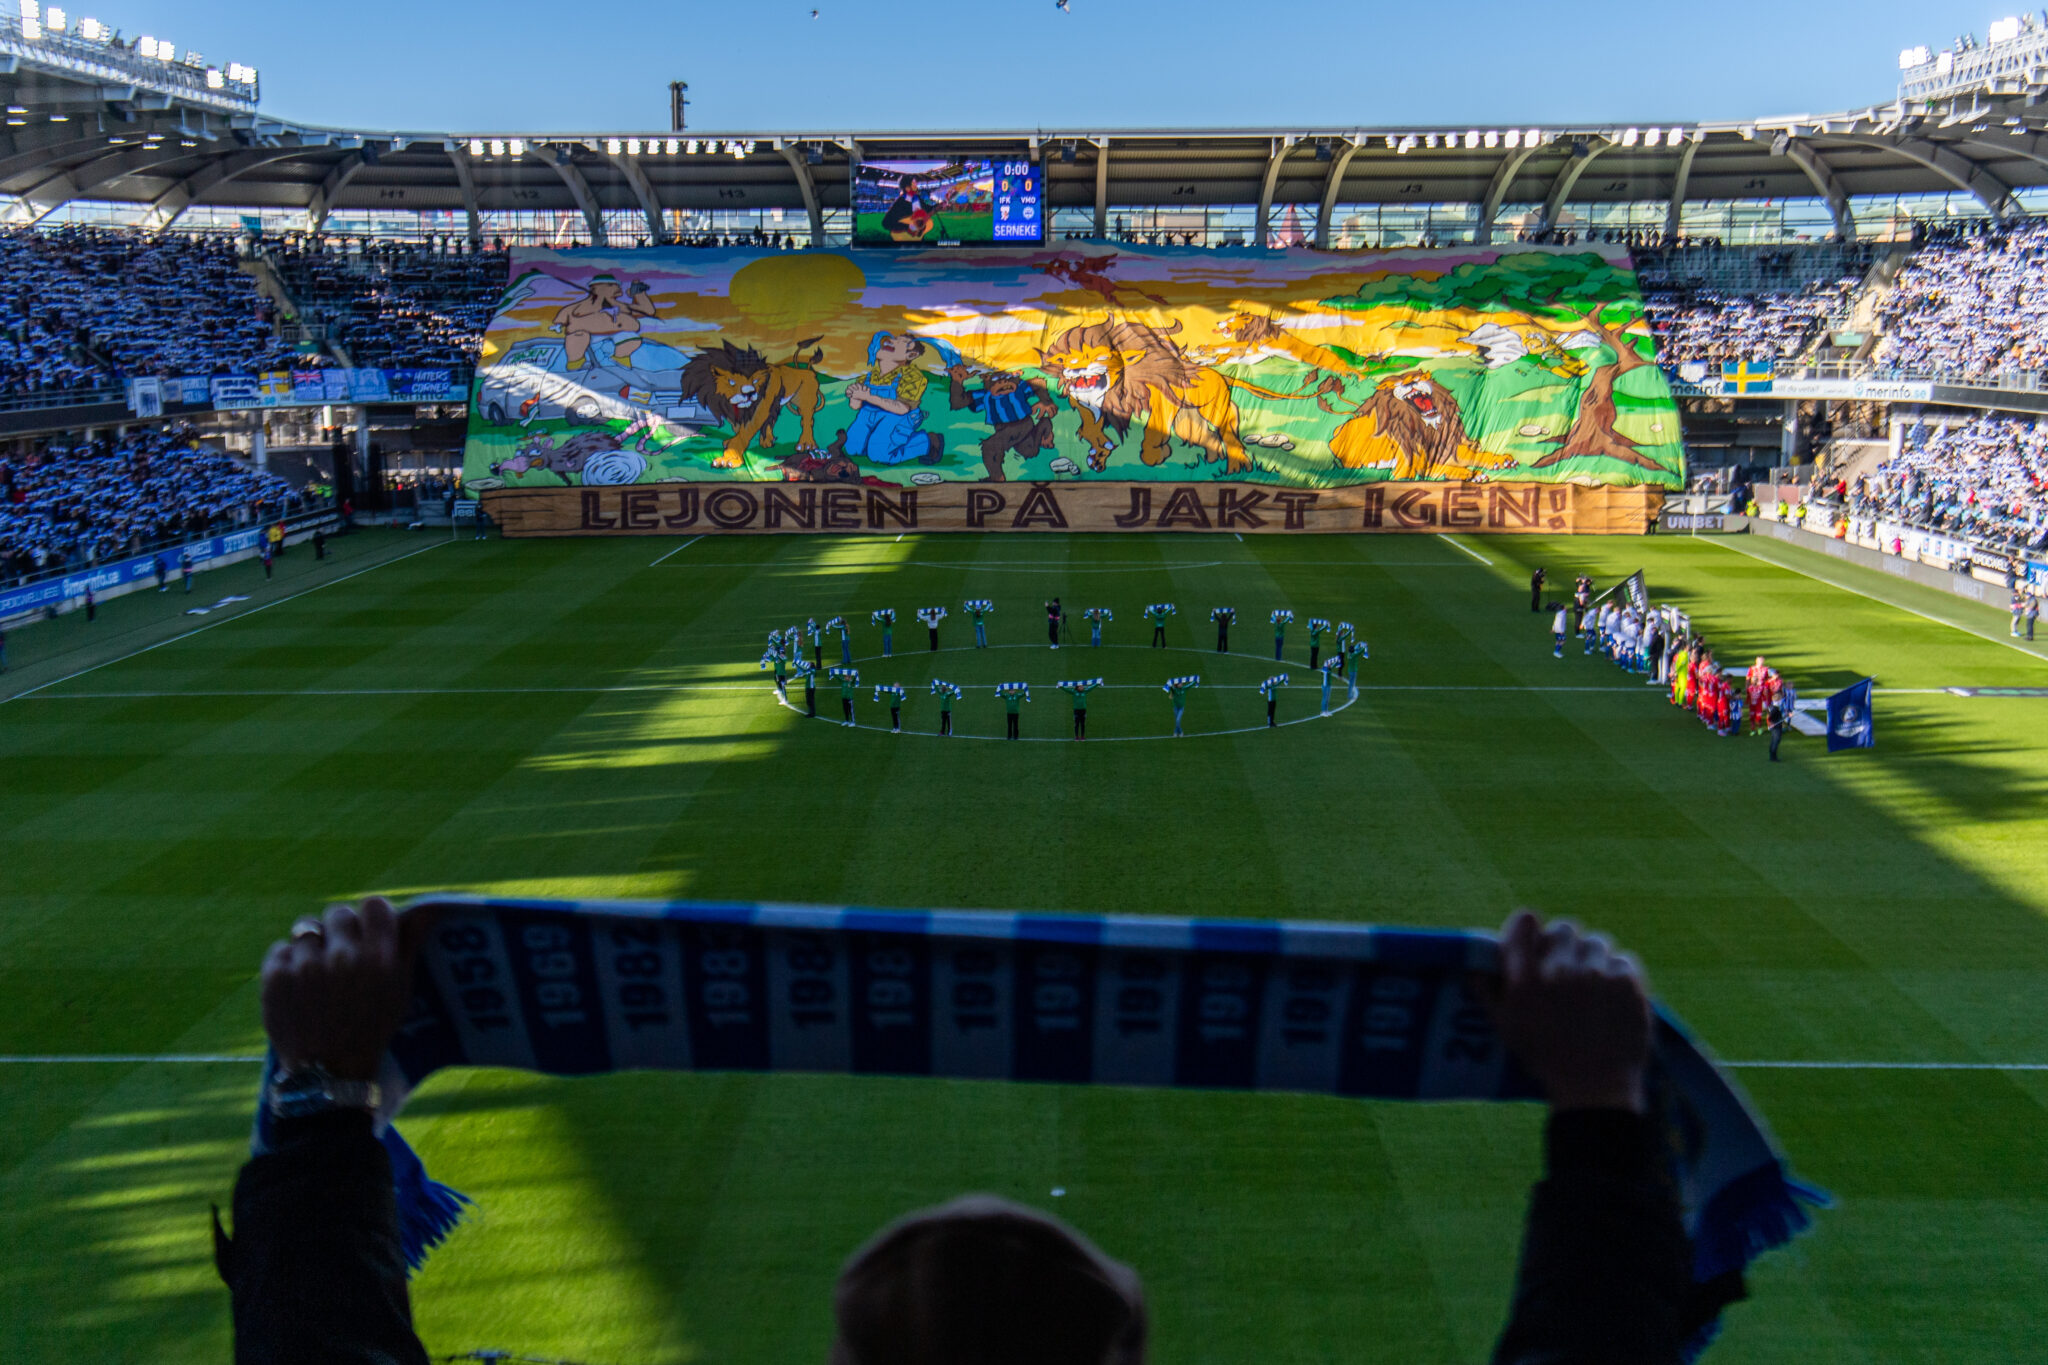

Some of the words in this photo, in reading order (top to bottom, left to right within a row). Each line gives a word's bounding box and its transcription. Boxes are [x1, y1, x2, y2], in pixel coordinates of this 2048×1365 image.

[1004, 164, 1029, 176] 0:00
[1001, 179, 1009, 192] 0
[1024, 179, 1033, 192] 0
[994, 225, 1037, 237] SERNEKE
[411, 382, 449, 393] CORNER
[1670, 382, 1721, 396] merinf
[581, 487, 918, 530] LEJONEN
[966, 483, 1069, 528] PÅ
[1114, 486, 1319, 530] JAKT
[1362, 483, 1568, 530] IGEN!
[1667, 514, 1724, 529] UNIBET
[609, 923, 669, 1031] 1982
